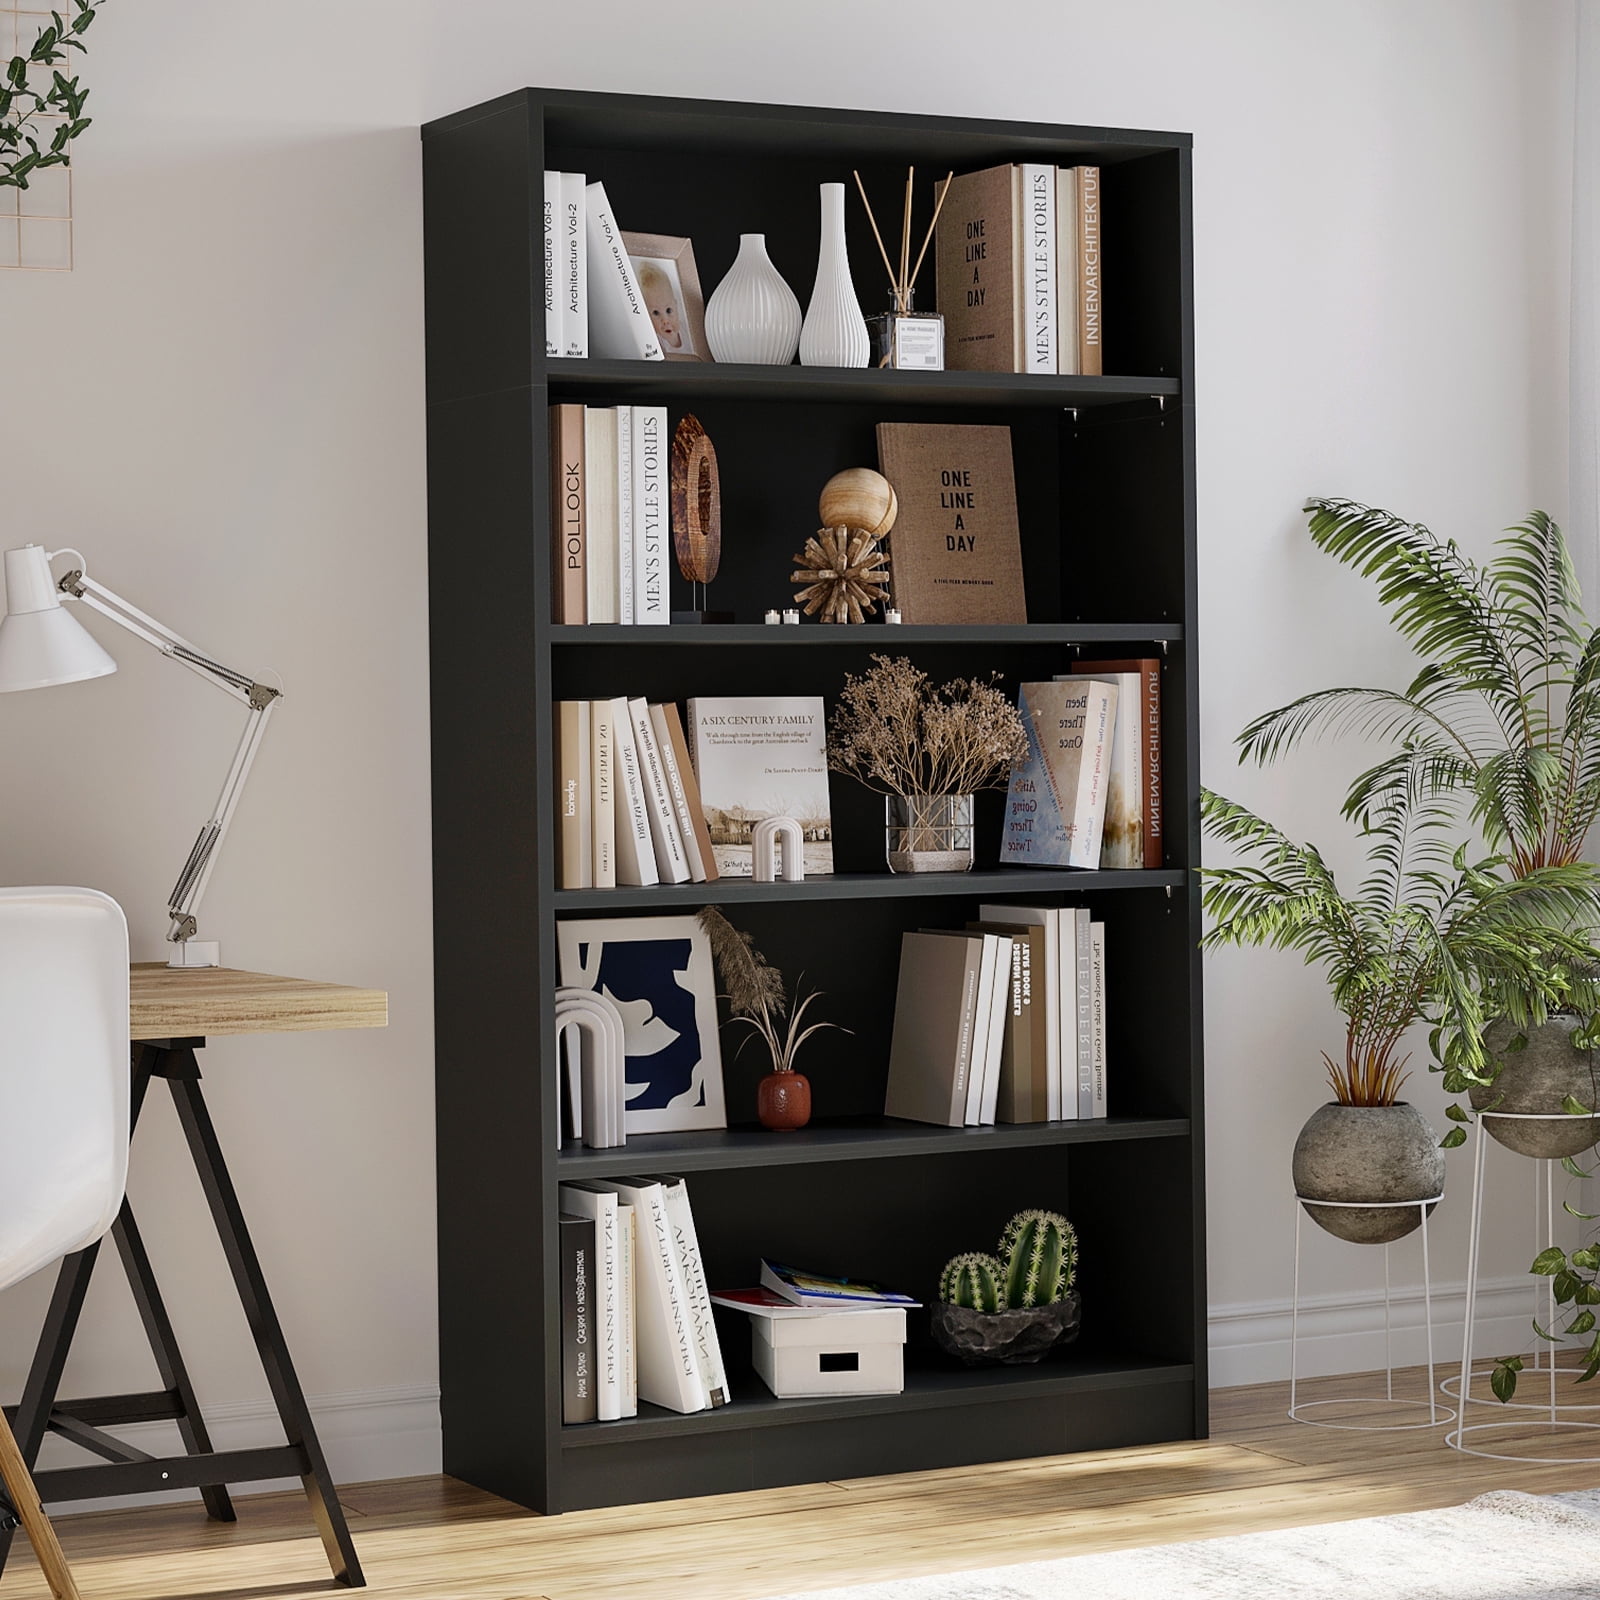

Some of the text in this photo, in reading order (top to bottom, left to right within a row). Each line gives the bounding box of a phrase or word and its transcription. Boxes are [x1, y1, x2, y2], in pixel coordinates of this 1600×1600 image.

[966, 220, 984, 240] ONE
[544, 201, 553, 312] Architecture Vol-3
[568, 203, 578, 313] Architecture Vol-2
[598, 214, 640, 315] Architecture Vol-1
[966, 242, 986, 263] LINE
[1034, 174, 1049, 364] MEN'S STYLE STORIES
[1084, 167, 1098, 345] INNENARCHITEKTUR
[973, 266, 979, 284] A
[968, 288, 986, 307] DAY
[622, 412, 631, 500] REVOLUTION
[942, 470, 971, 487] ONE
[566, 462, 581, 569] POLLOCK
[644, 416, 660, 612] MEN'S STYLE STORIES
[941, 492, 974, 508] LINE
[623, 506, 631, 543] LOOK
[955, 514, 964, 530] A
[946, 536, 976, 552] DAY
[701, 716, 815, 725] A SIX CENTURY FAMILY
[576, 1250, 586, 1302] невозвратном
[576, 1316, 586, 1344] Сказки
[606, 1293, 616, 1385] JOHANNES
[668, 1286, 692, 1376] JOHANNES
[576, 1379, 586, 1398] Анна
